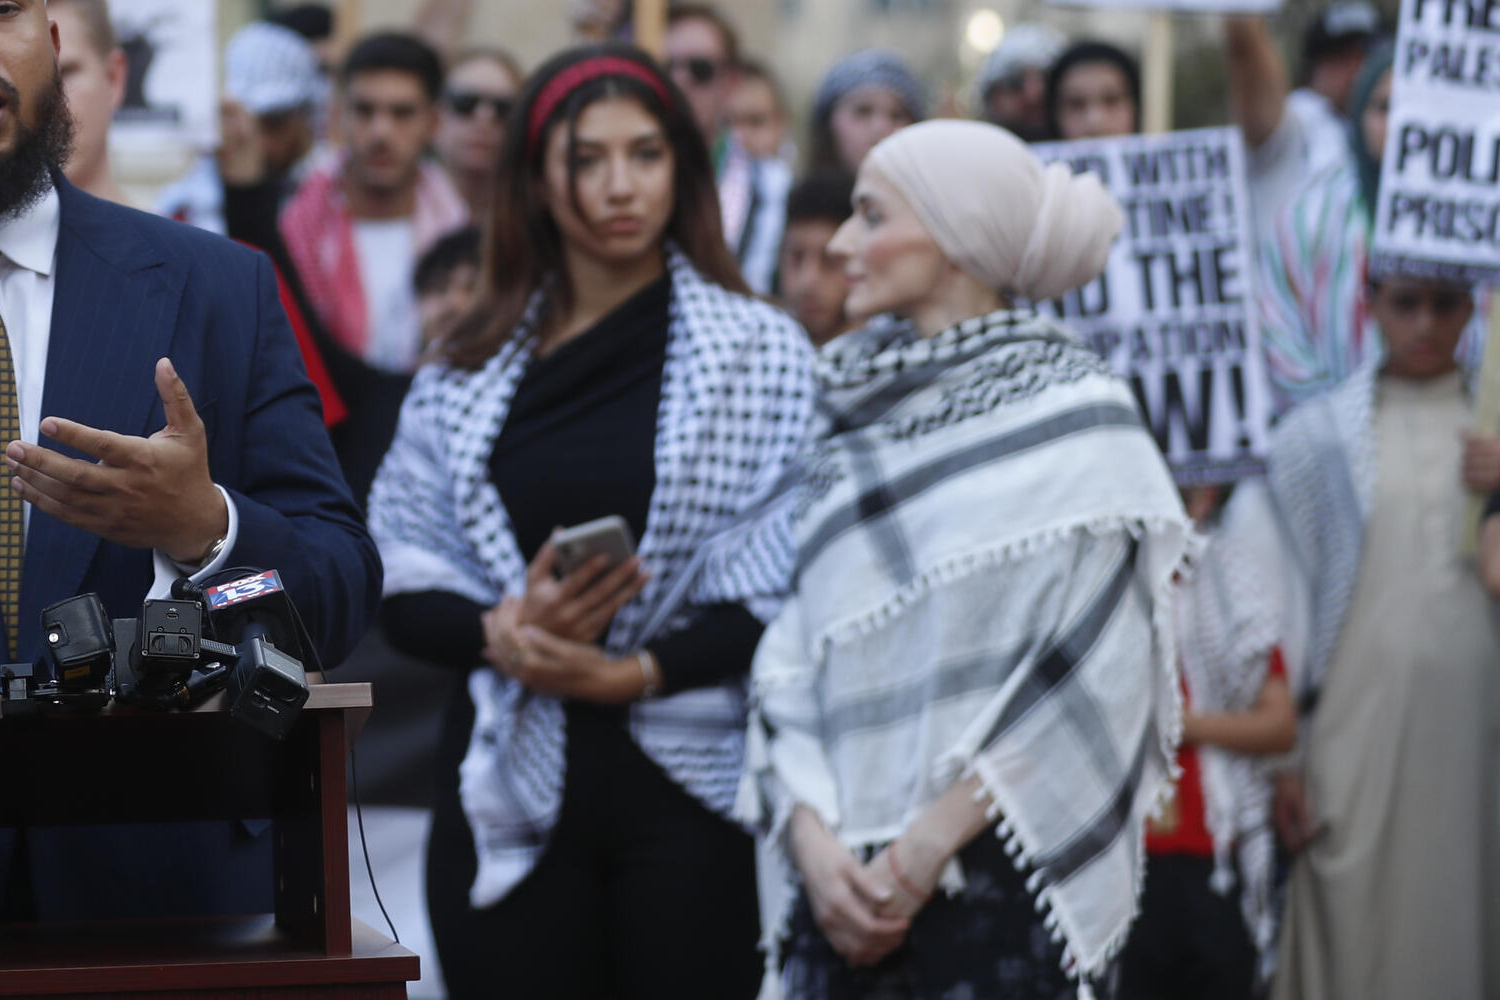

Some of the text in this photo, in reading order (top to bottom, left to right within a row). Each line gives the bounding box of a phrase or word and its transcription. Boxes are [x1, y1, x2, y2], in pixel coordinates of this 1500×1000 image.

[1124, 144, 1228, 186] WITH
[1132, 246, 1245, 310] THE
[215, 572, 267, 593] FOX
[221, 580, 266, 601] 13
